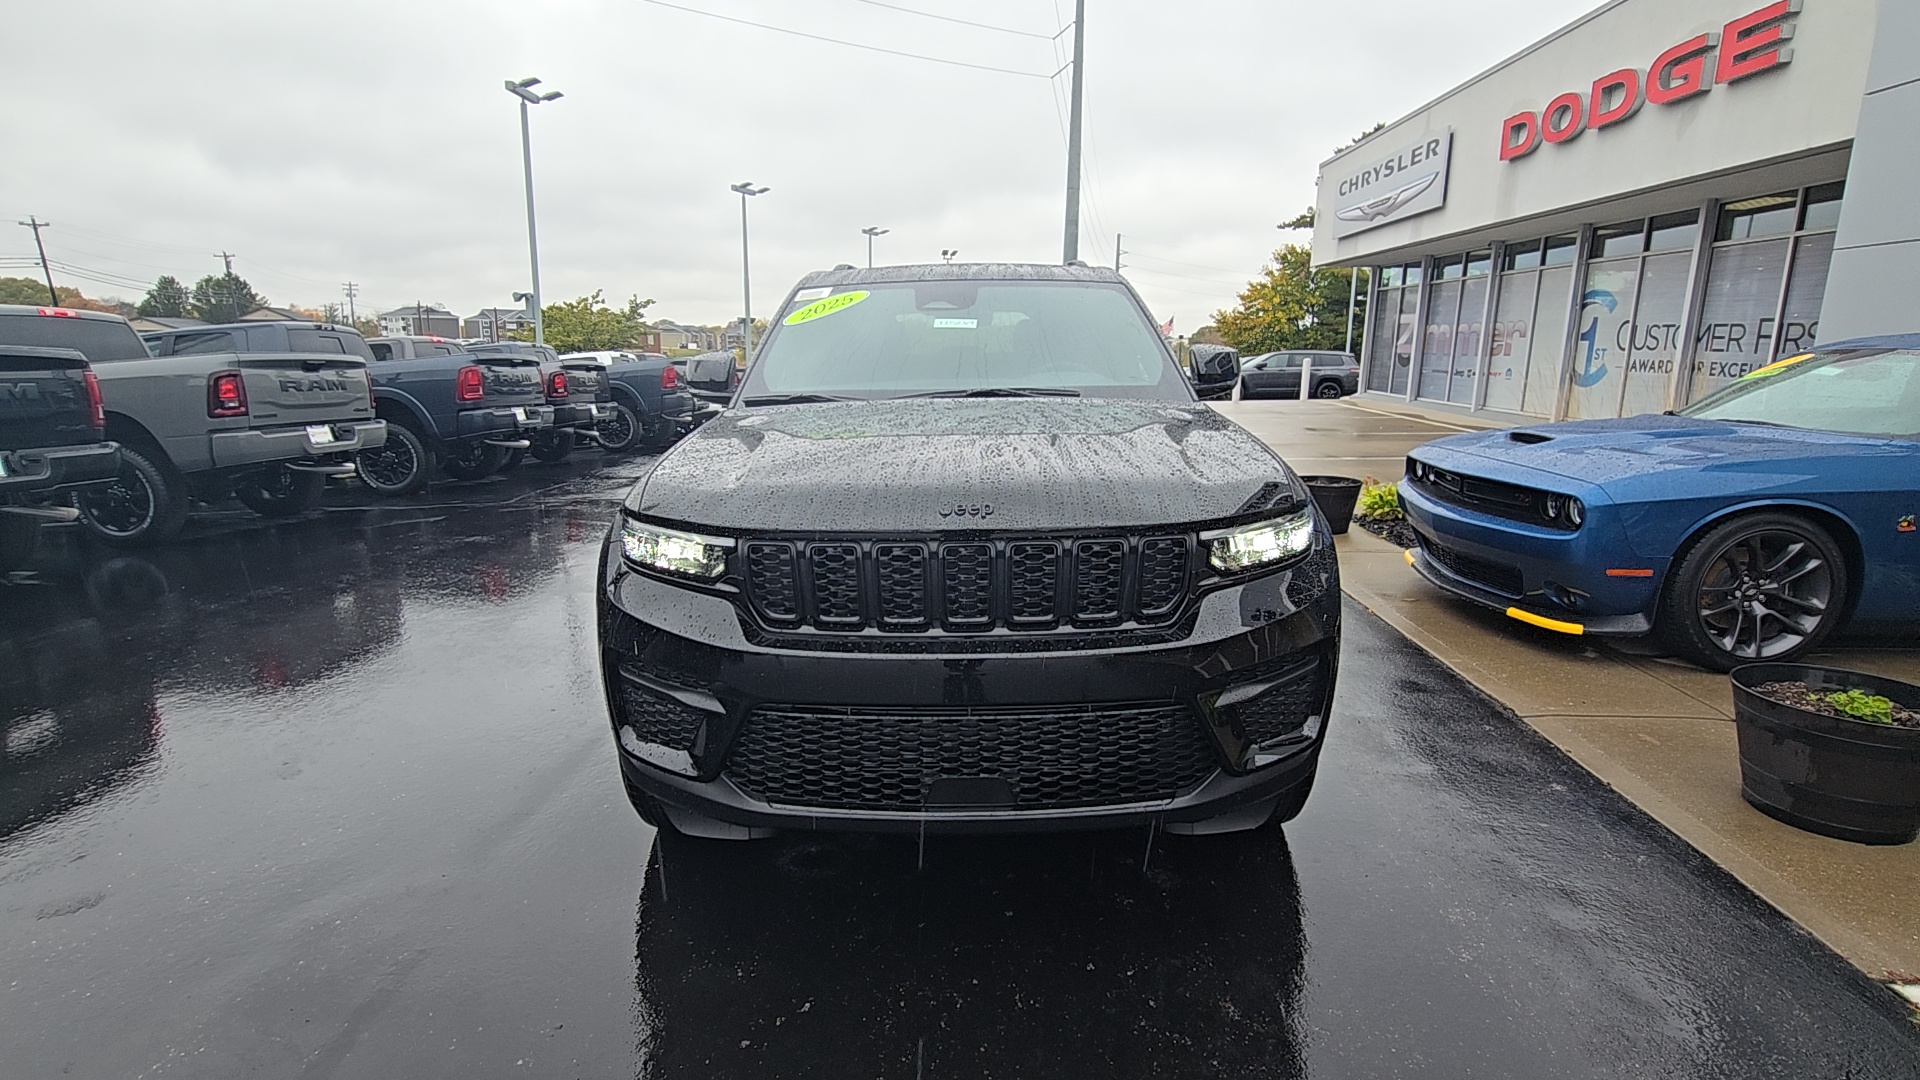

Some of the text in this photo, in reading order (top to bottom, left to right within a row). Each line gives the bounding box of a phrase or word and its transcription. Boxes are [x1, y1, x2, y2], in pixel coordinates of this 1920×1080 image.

[1499, 0, 1798, 162] DODGE
[1338, 138, 1441, 197] CHRYSLER
[800, 295, 854, 320] 2025
[1397, 314, 1527, 357] Zmmer
[1754, 317, 1819, 355] FRS
[1629, 357, 1674, 374] AWARD
[278, 379, 348, 393] RAM
[938, 501, 995, 520] Jeep
